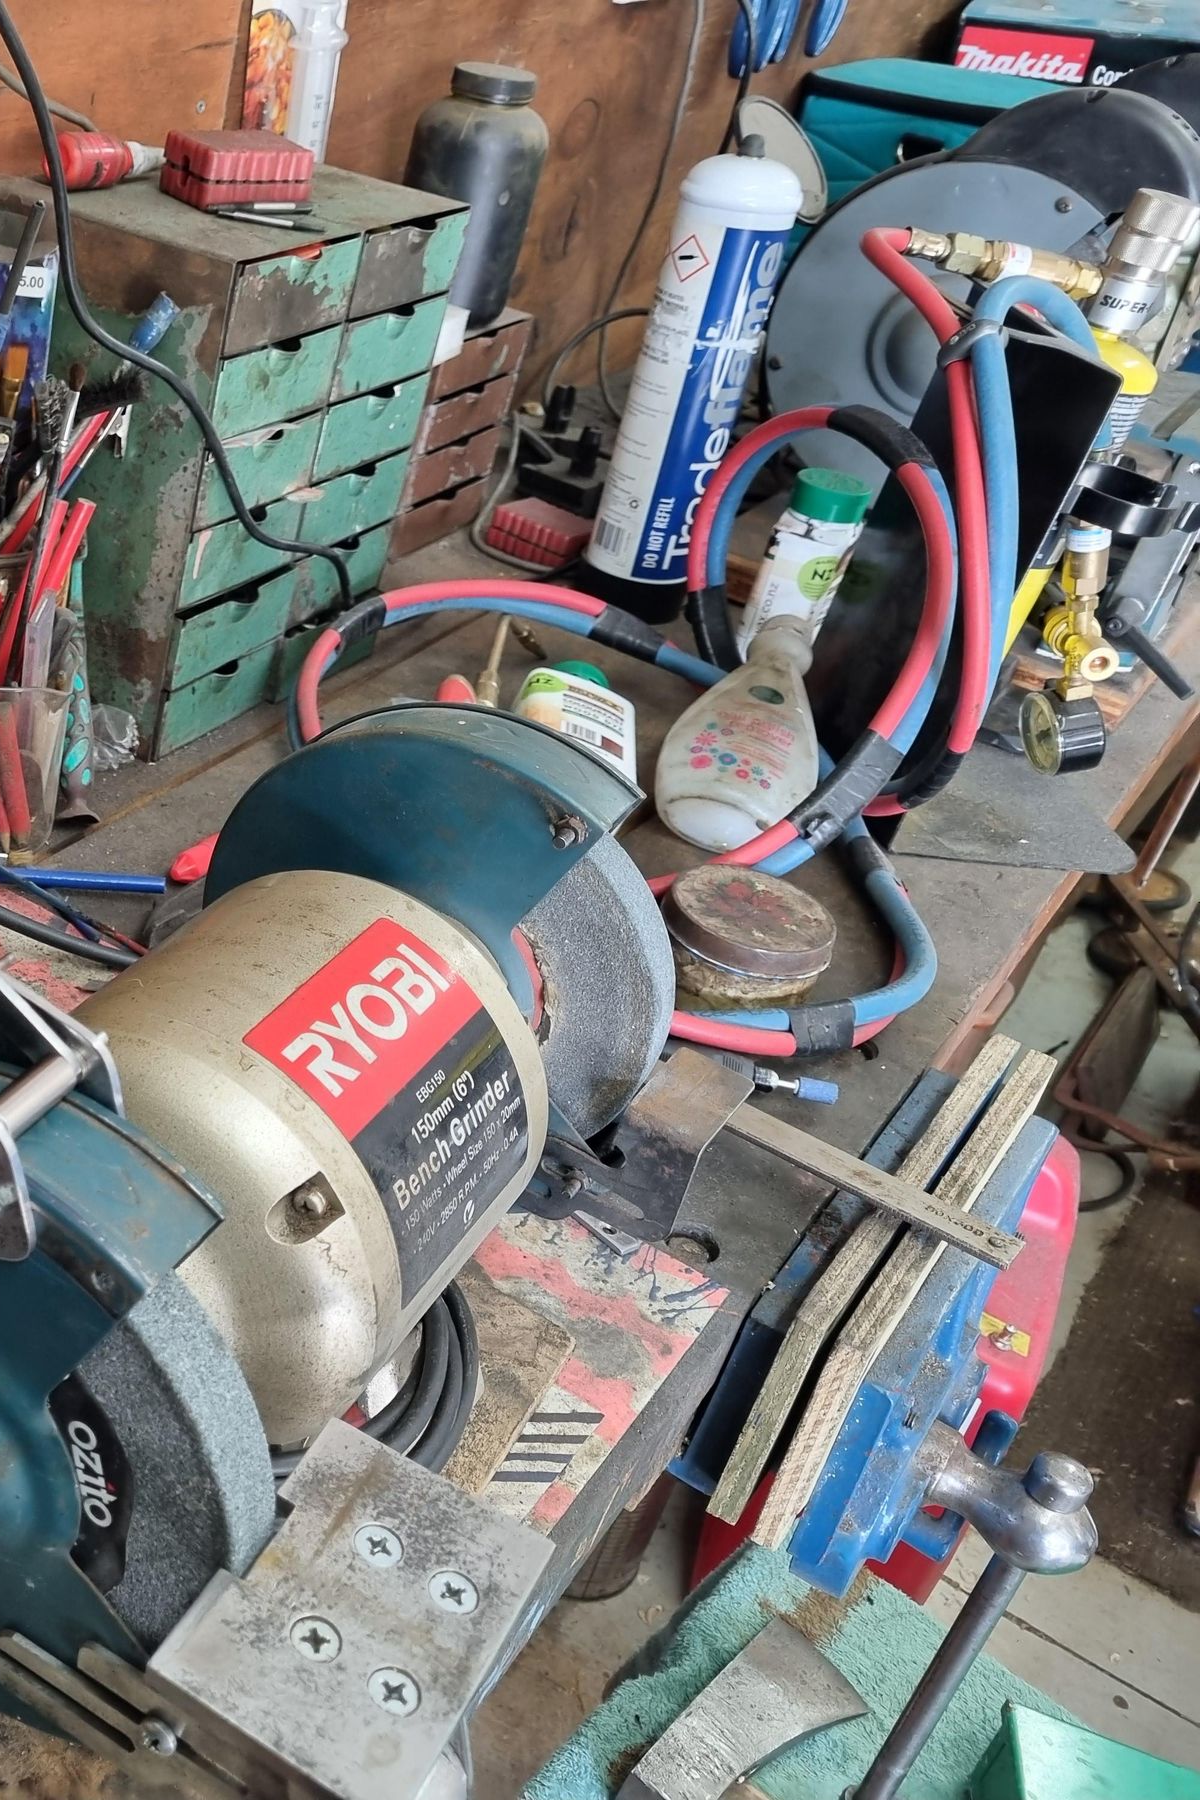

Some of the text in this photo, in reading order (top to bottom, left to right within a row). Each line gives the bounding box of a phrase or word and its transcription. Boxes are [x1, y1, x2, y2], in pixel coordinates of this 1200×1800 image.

[1092, 64, 1135, 86] Cor
[641, 496, 676, 569] DO NOT REFILL
[280, 943, 450, 1098] RYOBI
[416, 1069, 446, 1104] EBG150
[411, 1096, 455, 1144] 150mm
[445, 1154, 469, 1187] Wheel
[467, 1139, 483, 1161] Size
[483, 1121, 496, 1144] 150
[500, 1096, 521, 1125] 20mm
[483, 1149, 500, 1174] 50Hz
